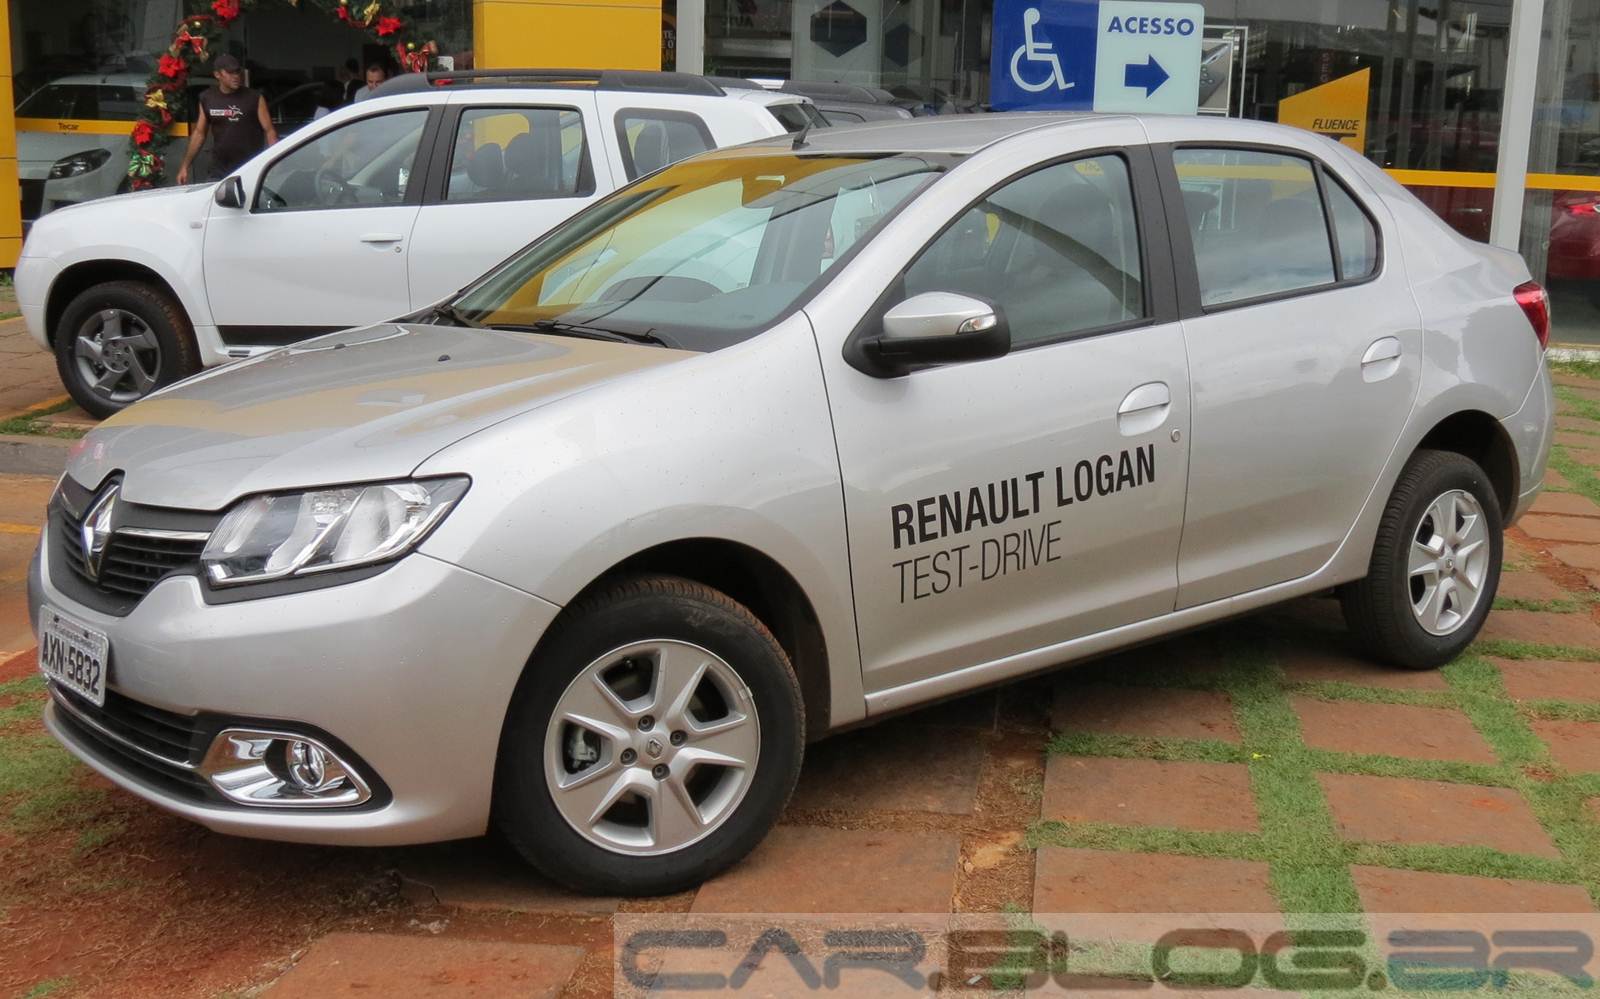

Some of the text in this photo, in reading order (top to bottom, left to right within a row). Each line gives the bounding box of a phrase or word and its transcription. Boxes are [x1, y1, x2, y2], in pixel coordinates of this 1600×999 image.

[1107, 16, 1194, 36] ACESSO
[1312, 118, 1359, 130] FLUENCE
[891, 444, 1155, 549] RENAULT LOGAN
[892, 520, 1062, 604] TEST-DRIVE
